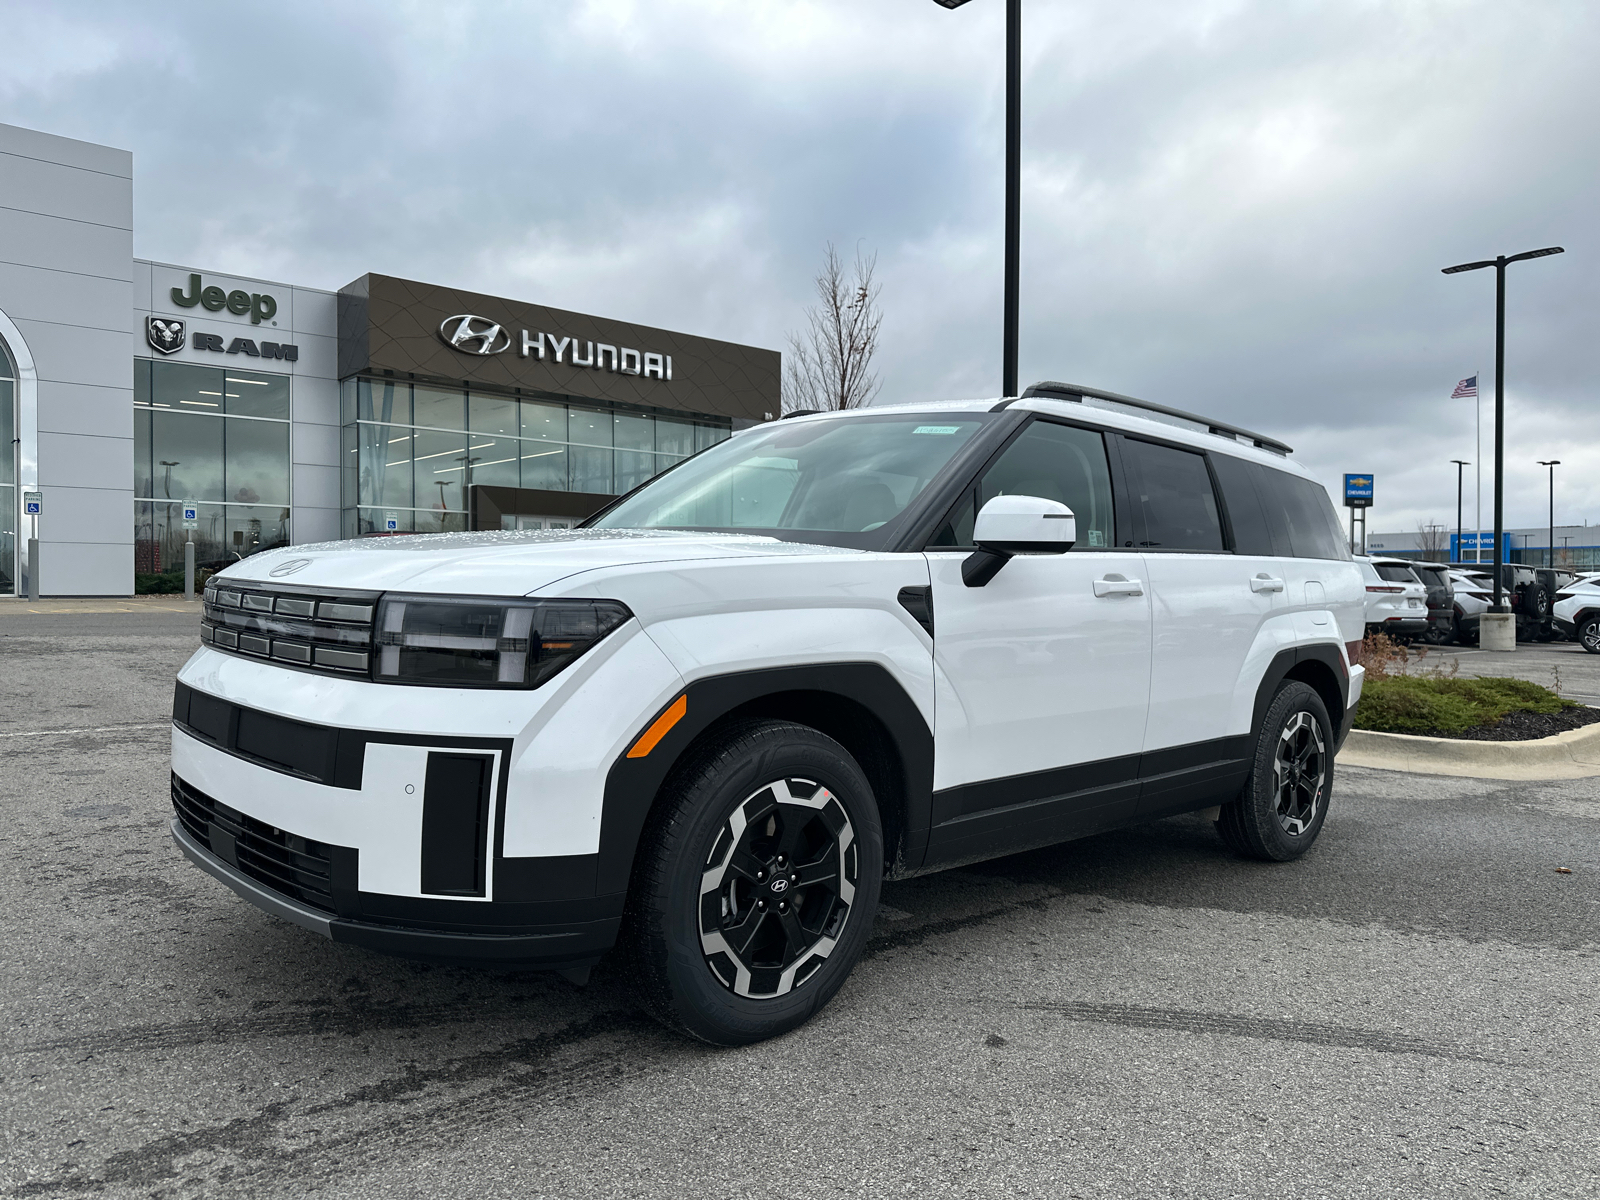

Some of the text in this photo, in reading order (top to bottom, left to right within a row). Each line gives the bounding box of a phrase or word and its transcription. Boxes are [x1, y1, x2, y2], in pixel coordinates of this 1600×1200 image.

[171, 273, 277, 325] Jeep
[193, 332, 298, 361] RAM
[520, 329, 672, 381] HYUNDAI
